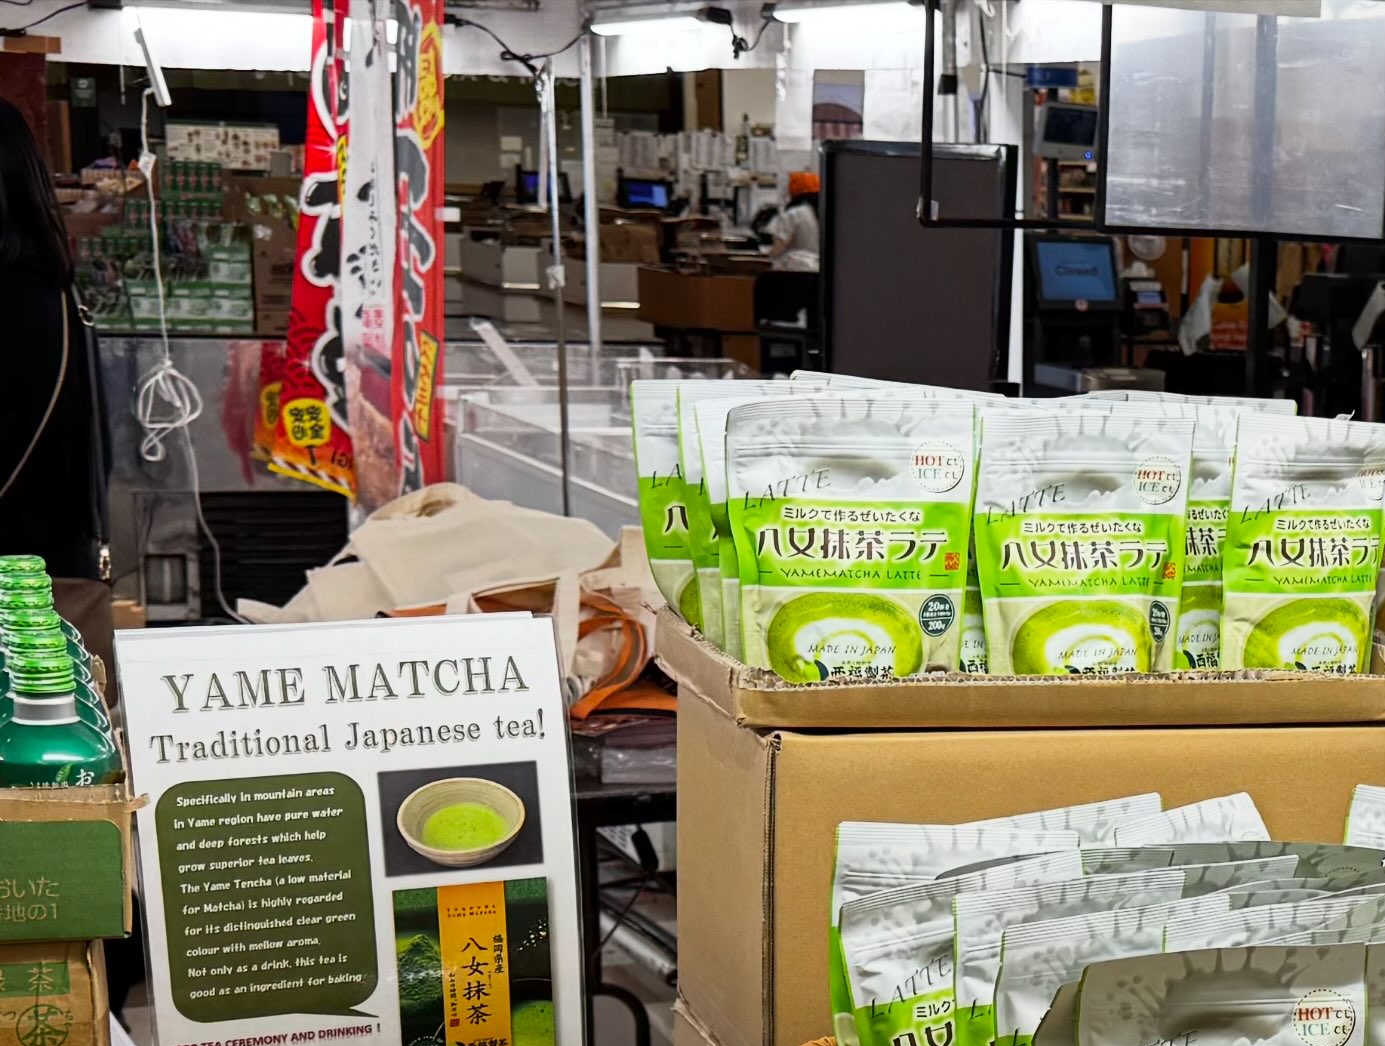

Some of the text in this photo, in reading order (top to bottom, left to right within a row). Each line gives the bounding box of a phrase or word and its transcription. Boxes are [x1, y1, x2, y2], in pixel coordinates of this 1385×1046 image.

[744, 469, 831, 511] LATTE
[784, 507, 920, 522] ミルクで作るぜいたくな
[1024, 522, 1141, 533] ミルクで作るぜいたくな
[758, 528, 947, 560] 八女抹茶ラテ
[1003, 541, 1167, 570] 八女抹茶ラテ
[781, 568, 921, 579] YAMEMATCHA LATTE
[162, 655, 530, 714] YAME MATCHA
[150, 709, 545, 764] Traditional Japanese tea!
[461, 937, 492, 1025] 八女抹茶
[291, 1031, 315, 1042] AND
[318, 1024, 372, 1039] DRINKING
